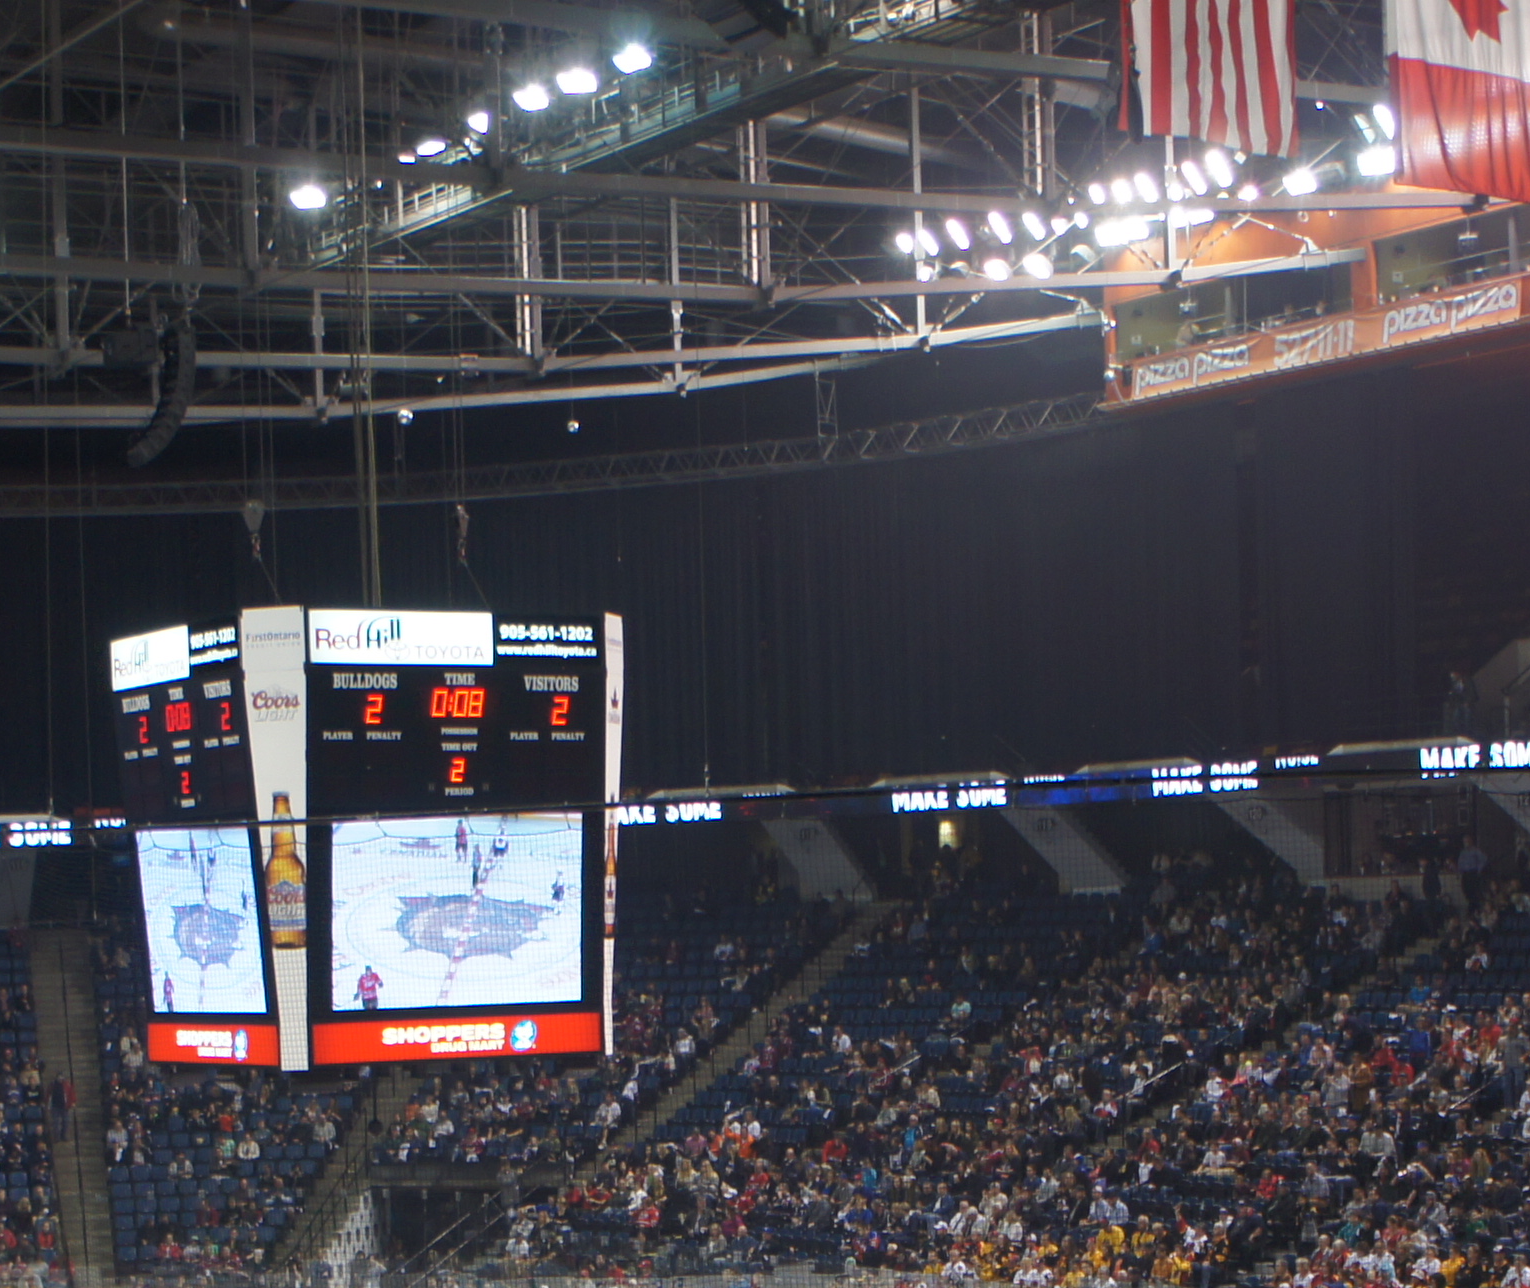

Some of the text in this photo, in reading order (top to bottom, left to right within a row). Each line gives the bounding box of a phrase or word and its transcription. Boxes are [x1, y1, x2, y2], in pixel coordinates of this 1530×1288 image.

[1383, 281, 1519, 344] pizza pizza
[1135, 343, 1250, 397] pizza pizza
[245, 632, 301, 643] FirstOntario
[315, 618, 368, 650] Red
[416, 645, 485, 660] TOYOTA
[498, 624, 593, 641] 905-561-1202
[333, 672, 398, 689] BULLDOGS
[444, 672, 475, 686] TIME
[524, 675, 579, 692] VISITORS
[251, 690, 300, 710] Coors
[364, 693, 384, 725] 2
[430, 686, 485, 718] 0:08
[551, 695, 569, 726] 2
[220, 702, 232, 730] 2
[255, 709, 298, 723] LIGHT
[138, 716, 150, 744] 2
[323, 731, 402, 741] PLAYER PENALTY
[510, 731, 585, 742] PLAYER PENALTY
[441, 742, 460, 752] TIME
[450, 757, 466, 783] 2
[180, 771, 191, 794] 2
[445, 786, 474, 797] PERIOD
[616, 805, 656, 826] AKE
[7, 820, 71, 847] SOME
[381, 1023, 505, 1046] SHOPPERS
[431, 1039, 505, 1053] DRUG MART
